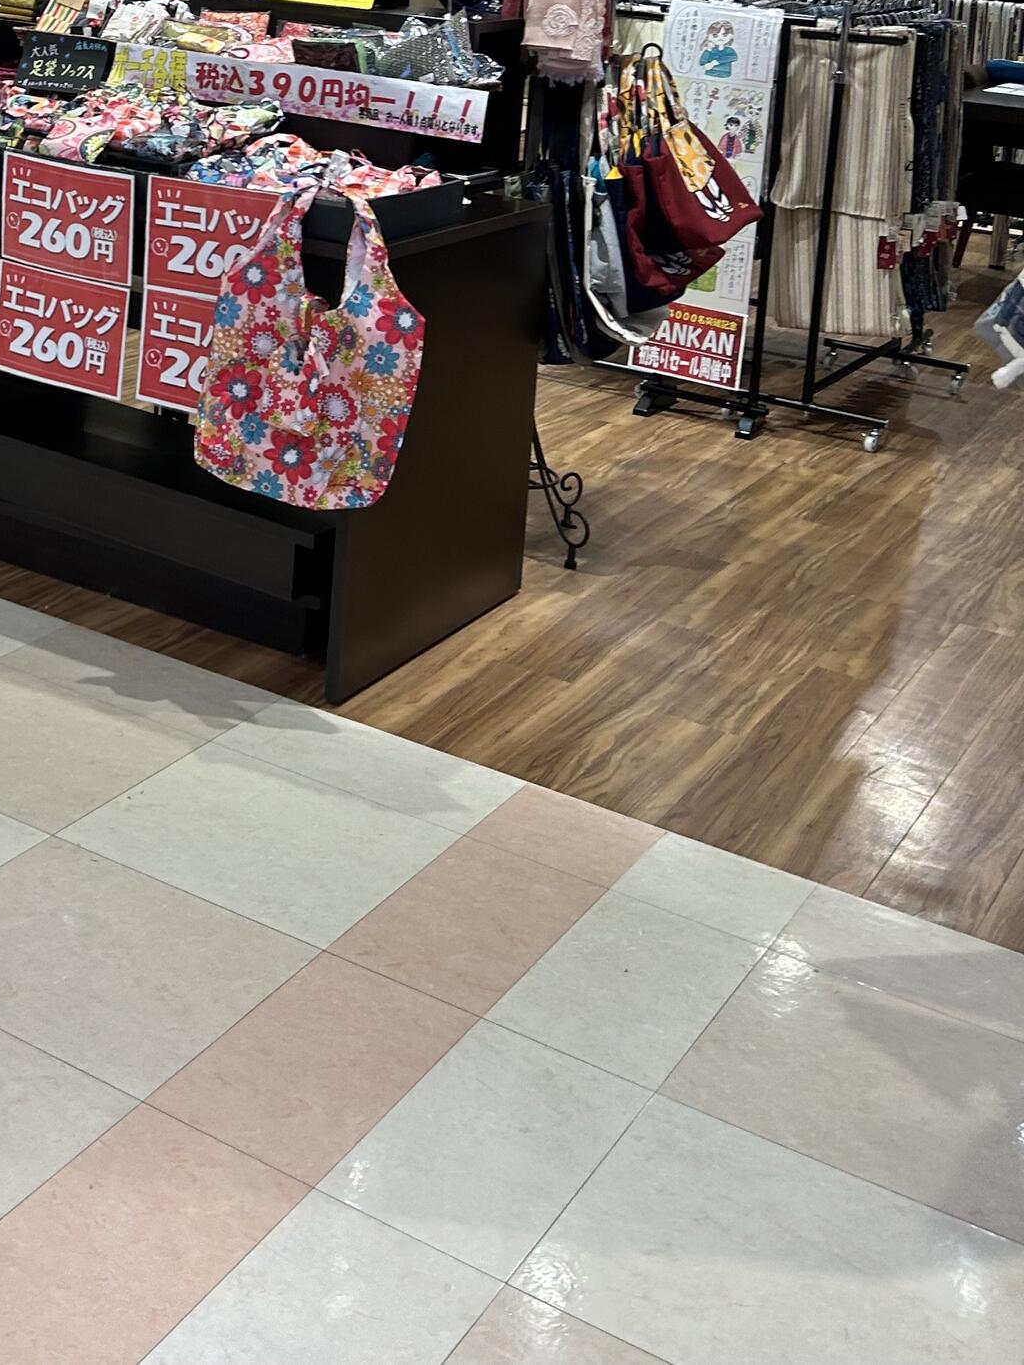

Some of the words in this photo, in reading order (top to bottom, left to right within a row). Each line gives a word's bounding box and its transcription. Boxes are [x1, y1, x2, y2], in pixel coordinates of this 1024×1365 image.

[9, 177, 126, 225] エコバッグ
[154, 200, 261, 240] エコバッ
[18, 211, 115, 263] 260円
[2, 284, 121, 335] エコバッグ
[9, 318, 106, 376] 260円
[648, 319, 735, 357] ANKAN
[638, 345, 733, 384] 初売りセール開催中
